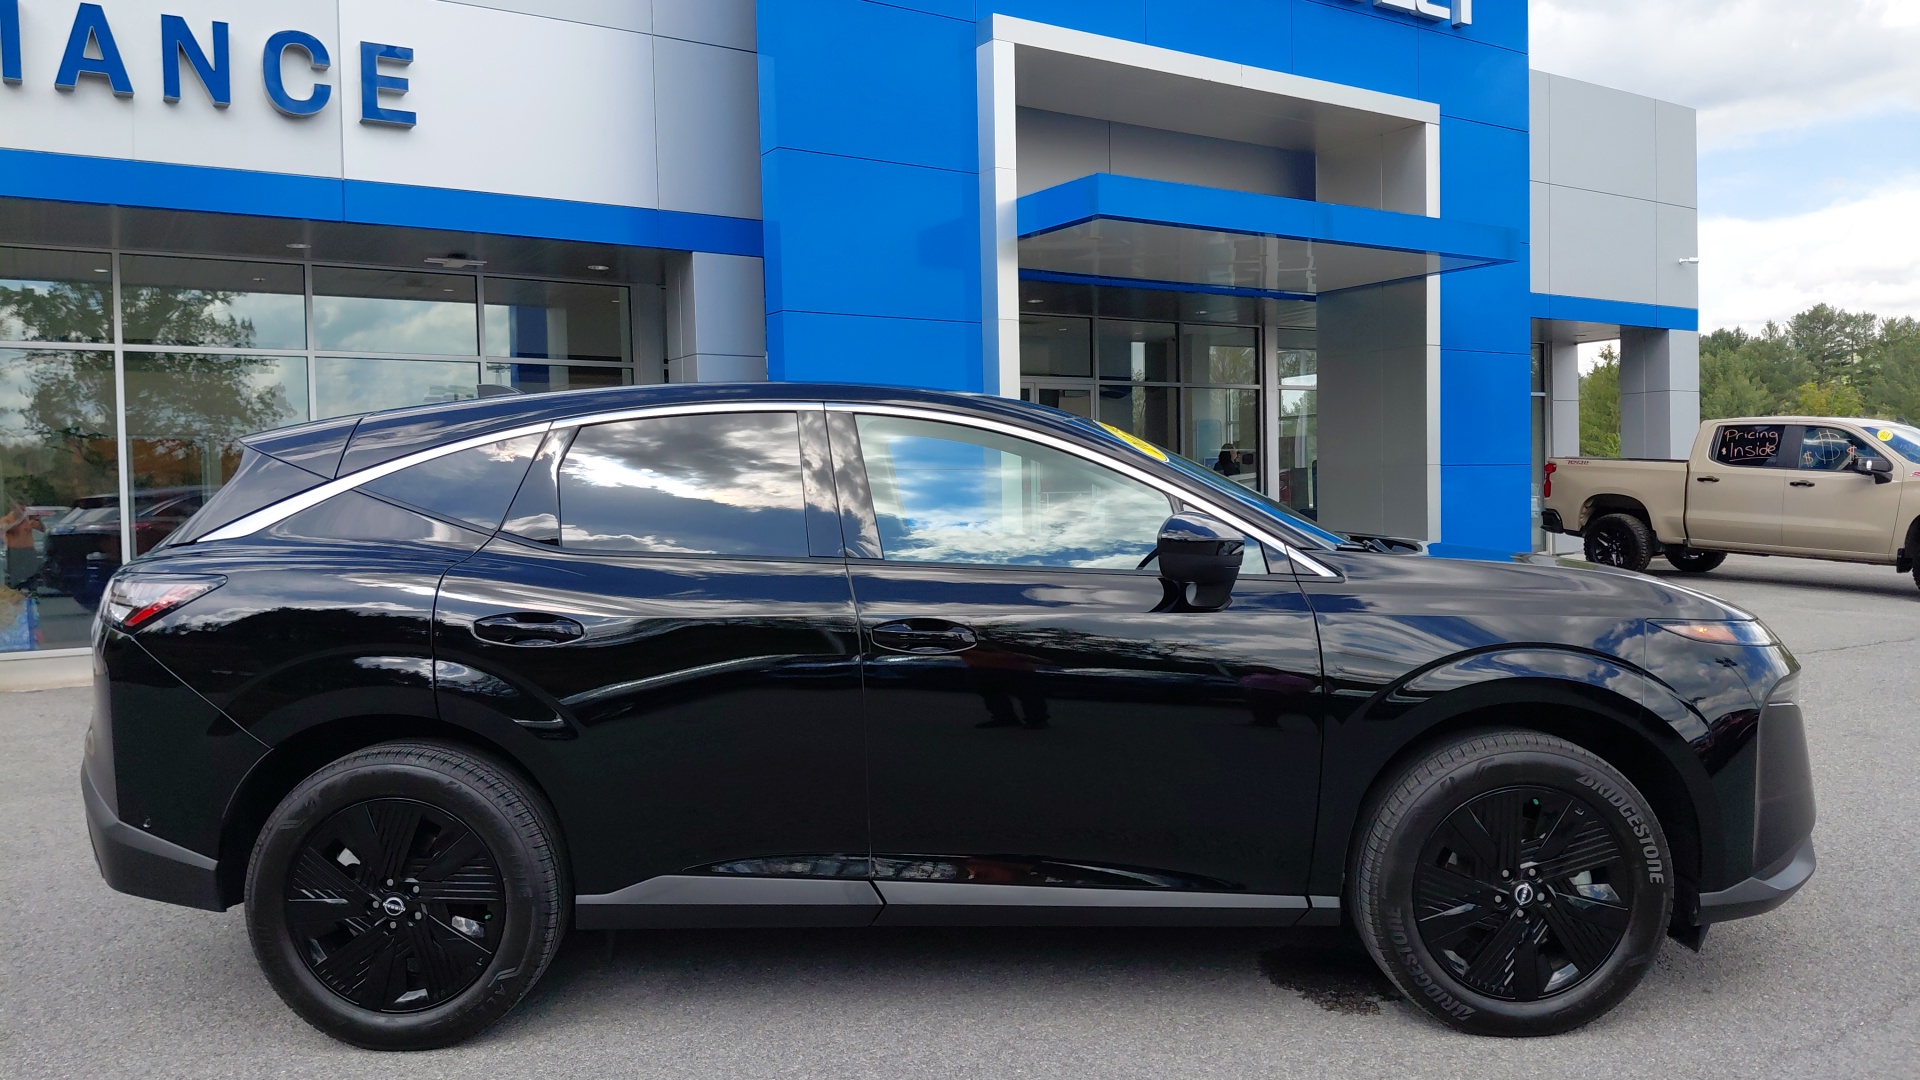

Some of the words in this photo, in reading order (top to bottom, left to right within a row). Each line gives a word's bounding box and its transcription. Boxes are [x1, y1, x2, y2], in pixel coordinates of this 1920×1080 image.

[1724, 429, 1779, 447] Pricing
[1730, 442, 1777, 457] Inside
[1576, 773, 1665, 884] BRIDGESTONE
